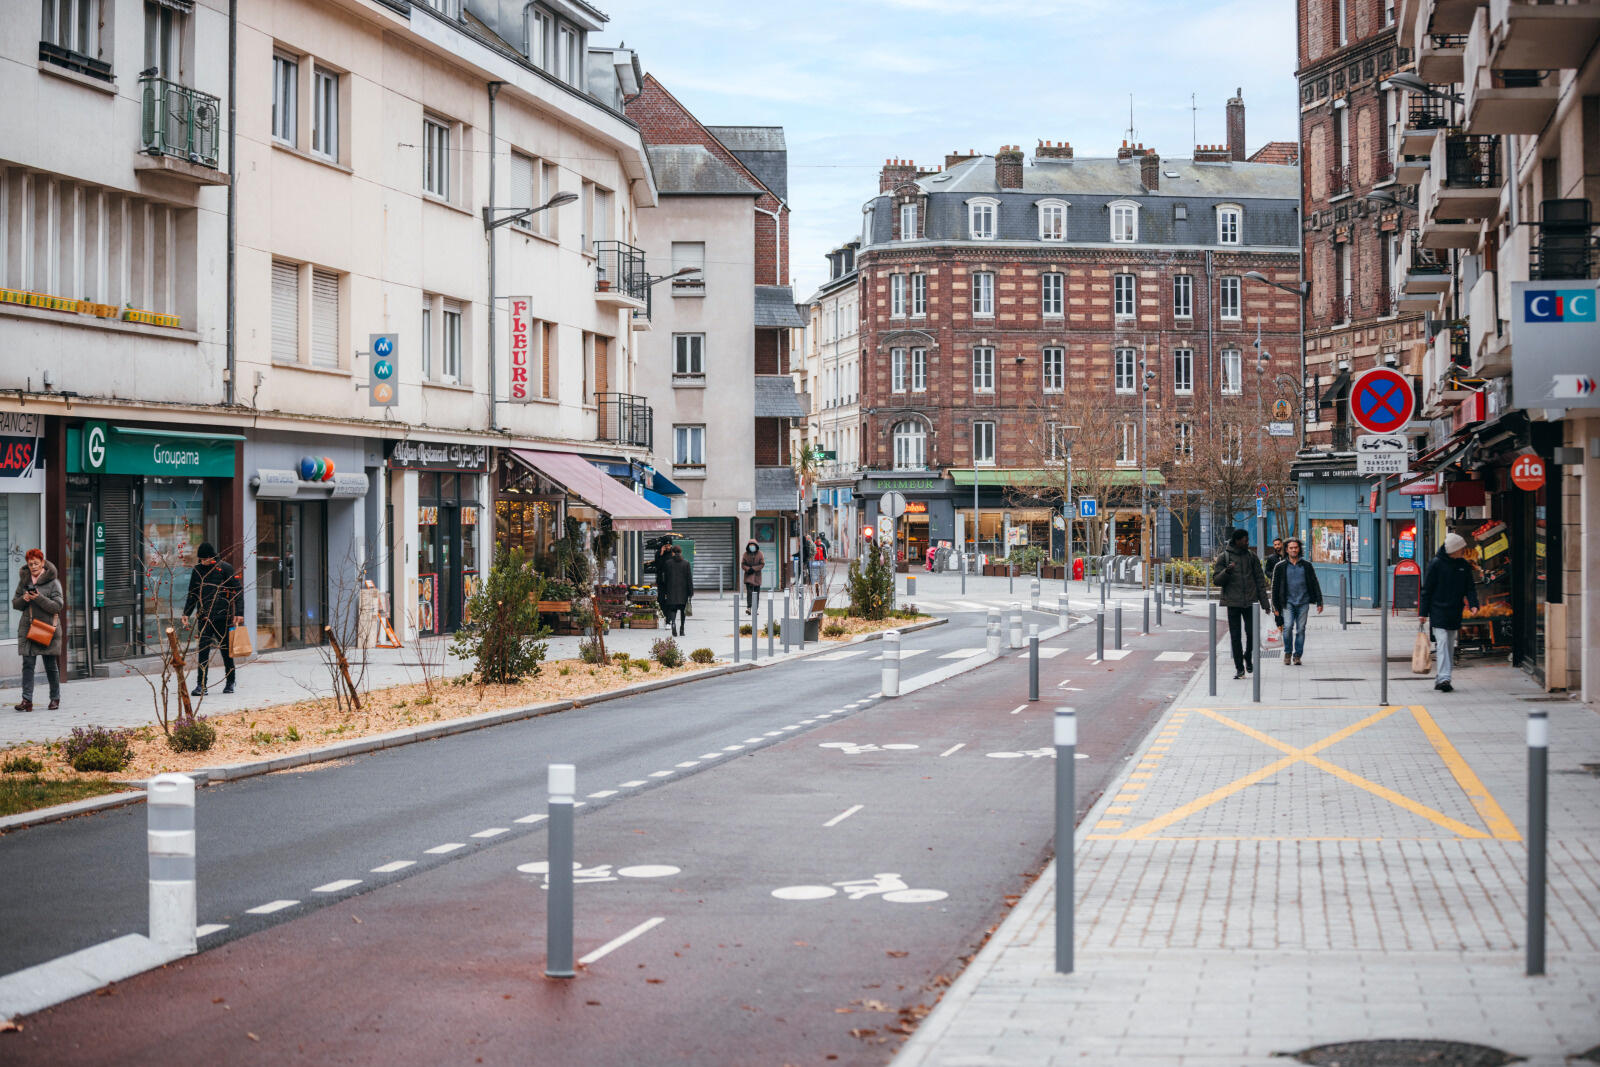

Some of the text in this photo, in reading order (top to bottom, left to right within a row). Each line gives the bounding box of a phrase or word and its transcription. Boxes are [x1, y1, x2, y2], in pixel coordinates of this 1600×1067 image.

[1530, 295, 1588, 317] CIC
[512, 301, 528, 398] FLEURS
[153, 442, 200, 468] Groupama
[1514, 457, 1543, 477] ria
[877, 479, 935, 489] PRIMEUR
